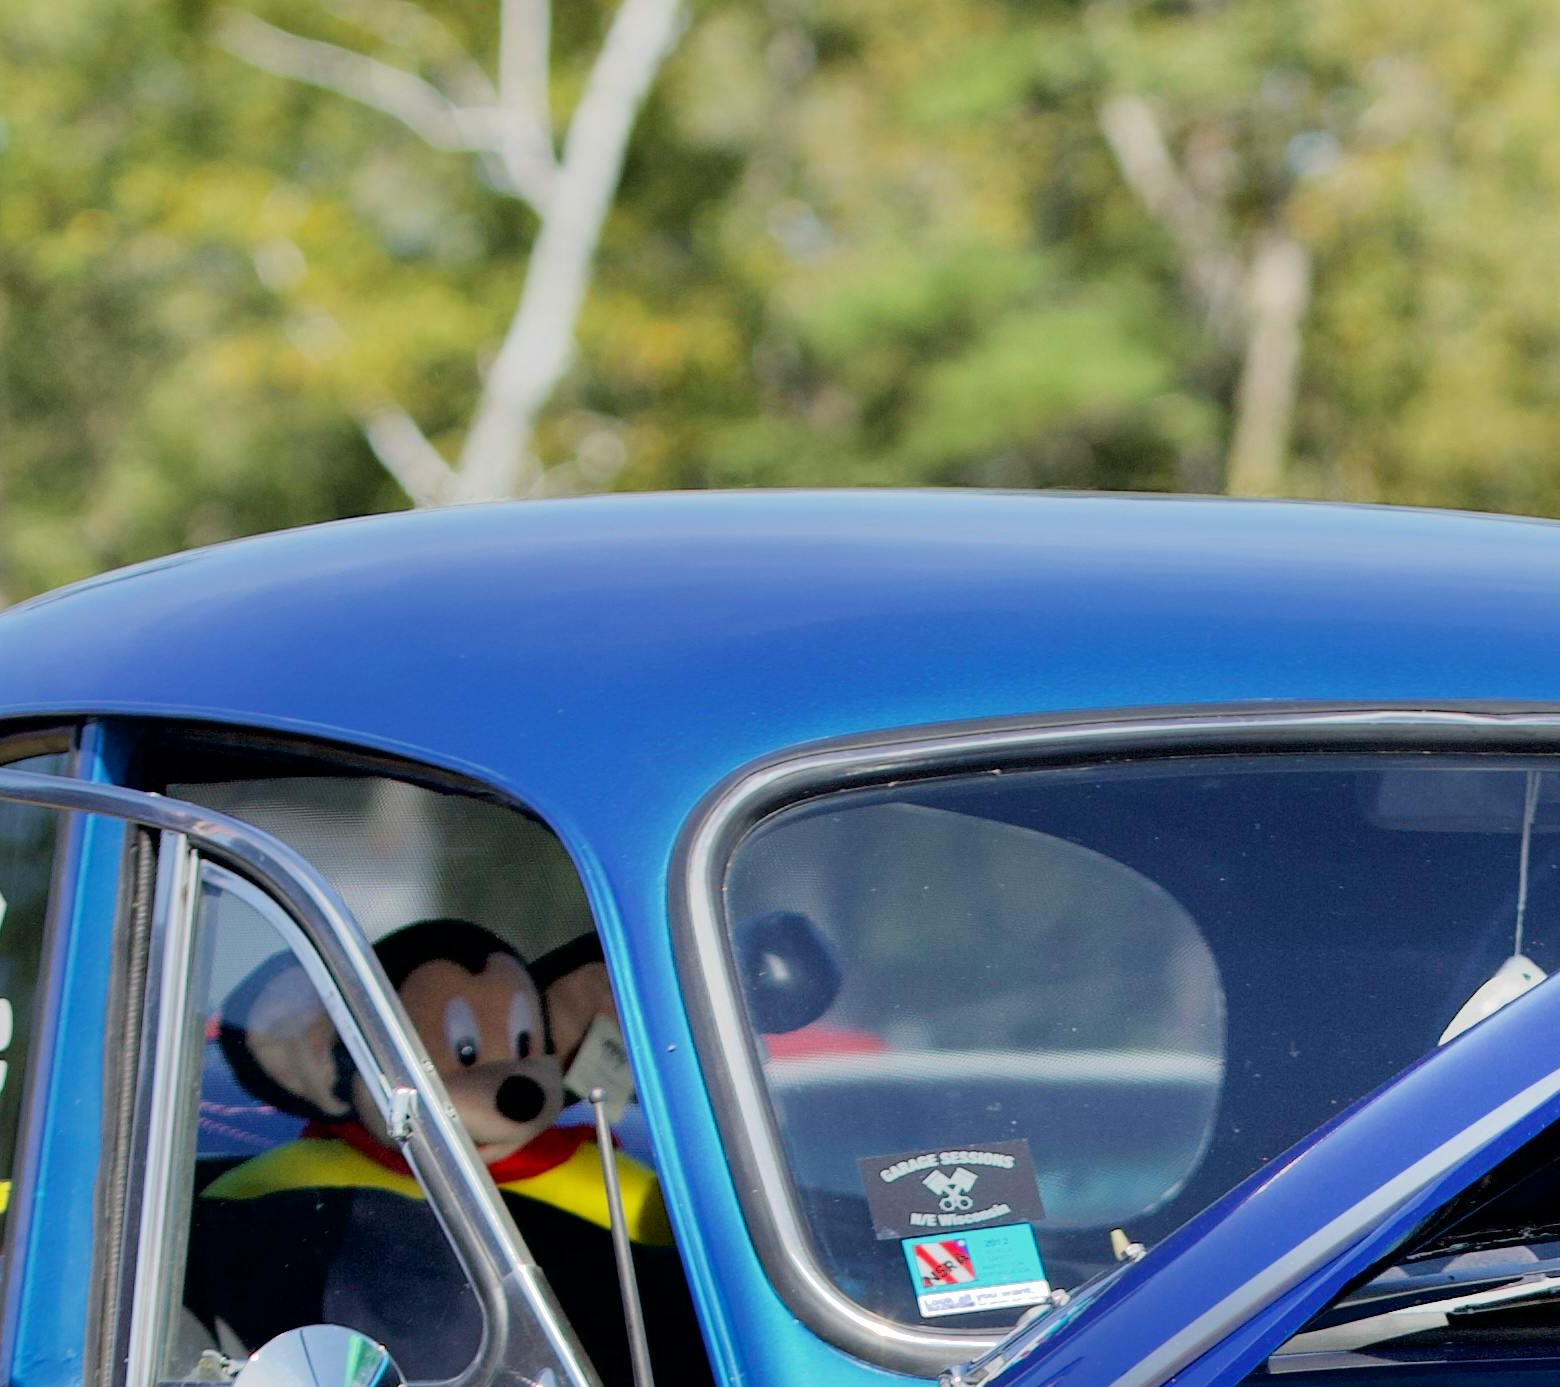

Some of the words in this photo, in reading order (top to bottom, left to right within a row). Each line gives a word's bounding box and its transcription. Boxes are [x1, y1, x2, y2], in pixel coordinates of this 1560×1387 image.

[880, 1153, 939, 1183] GARAGE
[939, 1150, 1016, 1169] SESSIONS
[938, 1203, 1012, 1227] Wisconsin
